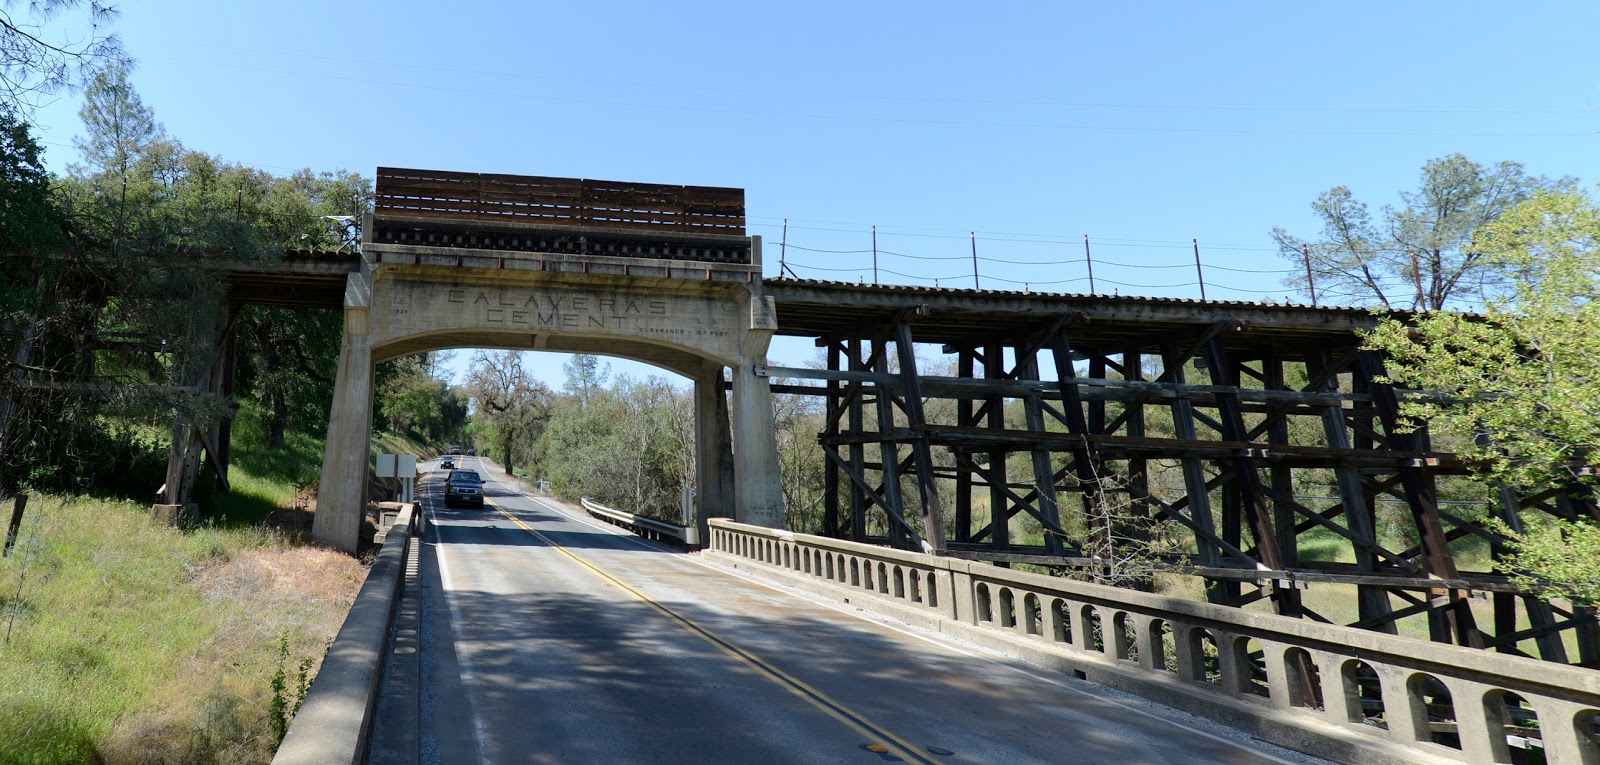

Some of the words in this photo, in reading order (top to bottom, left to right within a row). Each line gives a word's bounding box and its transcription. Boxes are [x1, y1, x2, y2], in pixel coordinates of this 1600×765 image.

[448, 290, 667, 315] CALAVERAS
[486, 308, 628, 329] CEMENT
[639, 327, 685, 335] CLEARANCE
